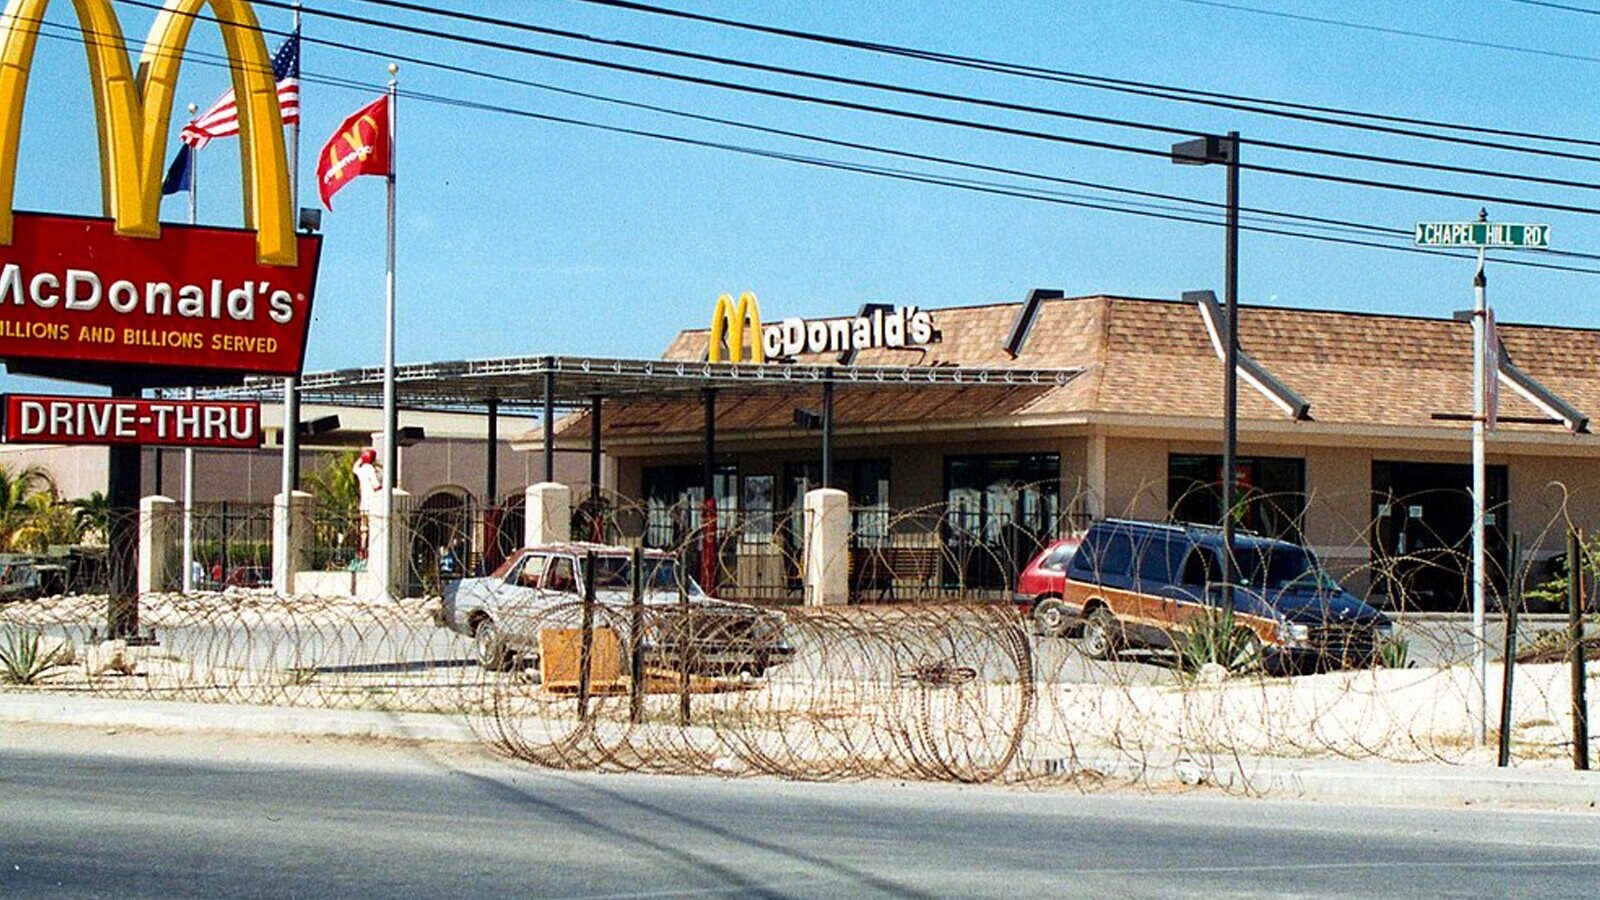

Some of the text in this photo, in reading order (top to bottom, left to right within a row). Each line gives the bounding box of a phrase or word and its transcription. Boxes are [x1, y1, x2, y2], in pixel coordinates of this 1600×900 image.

[1424, 223, 1542, 246] CHAPEL HILL RD
[0, 263, 294, 324] McDonald's
[0, 320, 278, 354] ILLIONS AND BILLIONS SERVED
[20, 400, 254, 441] DRIVE-THRU
